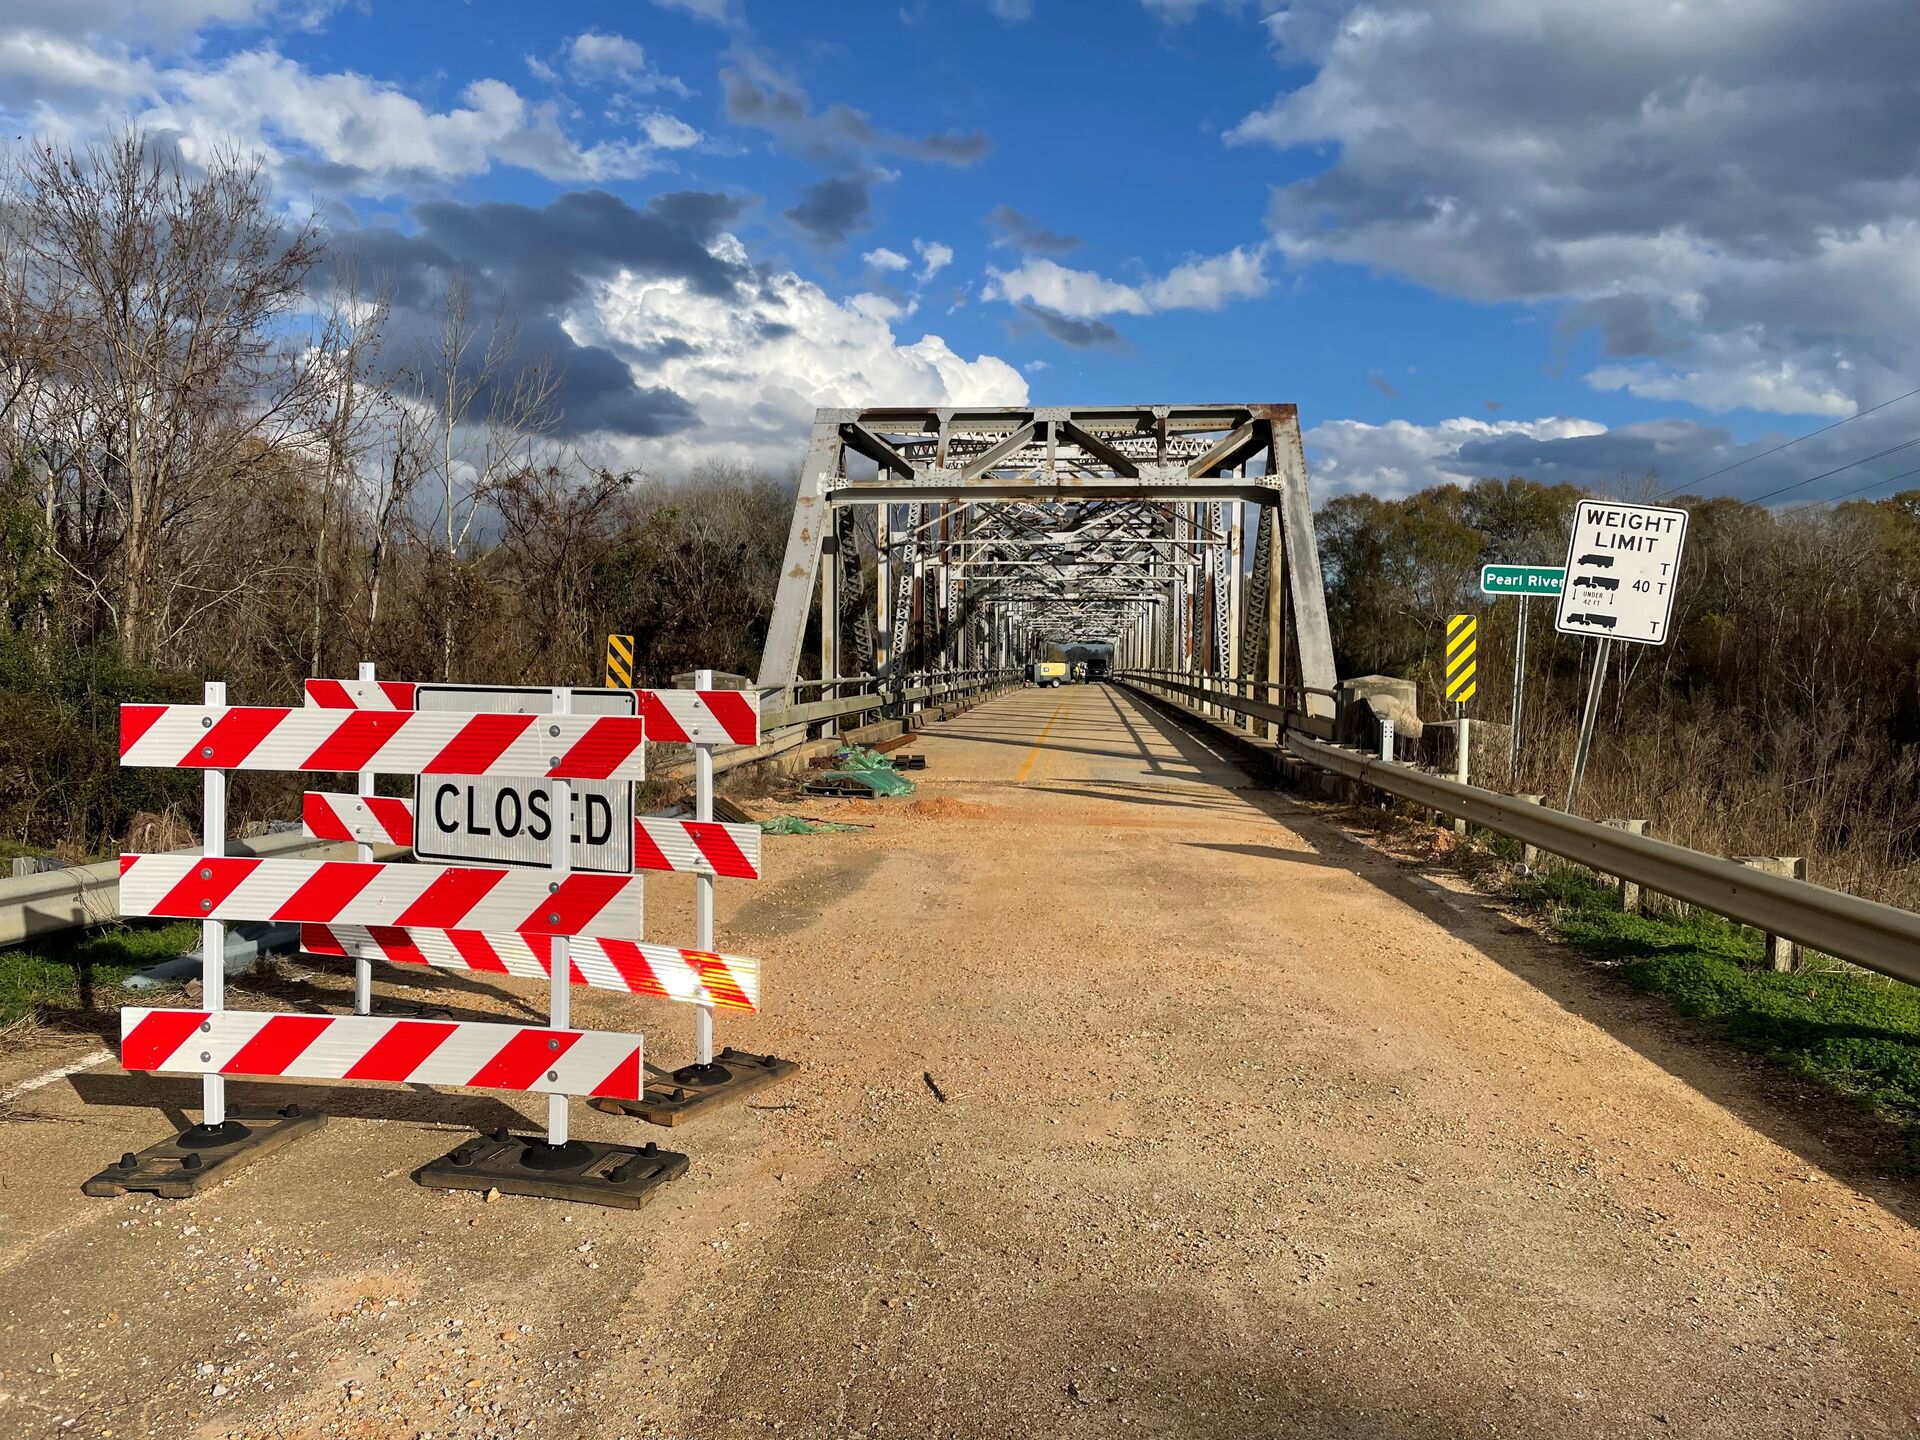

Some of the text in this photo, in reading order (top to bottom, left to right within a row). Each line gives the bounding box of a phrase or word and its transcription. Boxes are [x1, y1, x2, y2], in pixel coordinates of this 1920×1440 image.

[1587, 509, 1677, 534] WEIGHT
[1595, 531, 1659, 553] LIMIT
[1660, 562, 1671, 576] T
[1486, 573, 1565, 588] Pearl River
[1632, 579, 1667, 595] 40 T
[1583, 591, 1604, 599] UNDER
[1650, 621, 1660, 634] T
